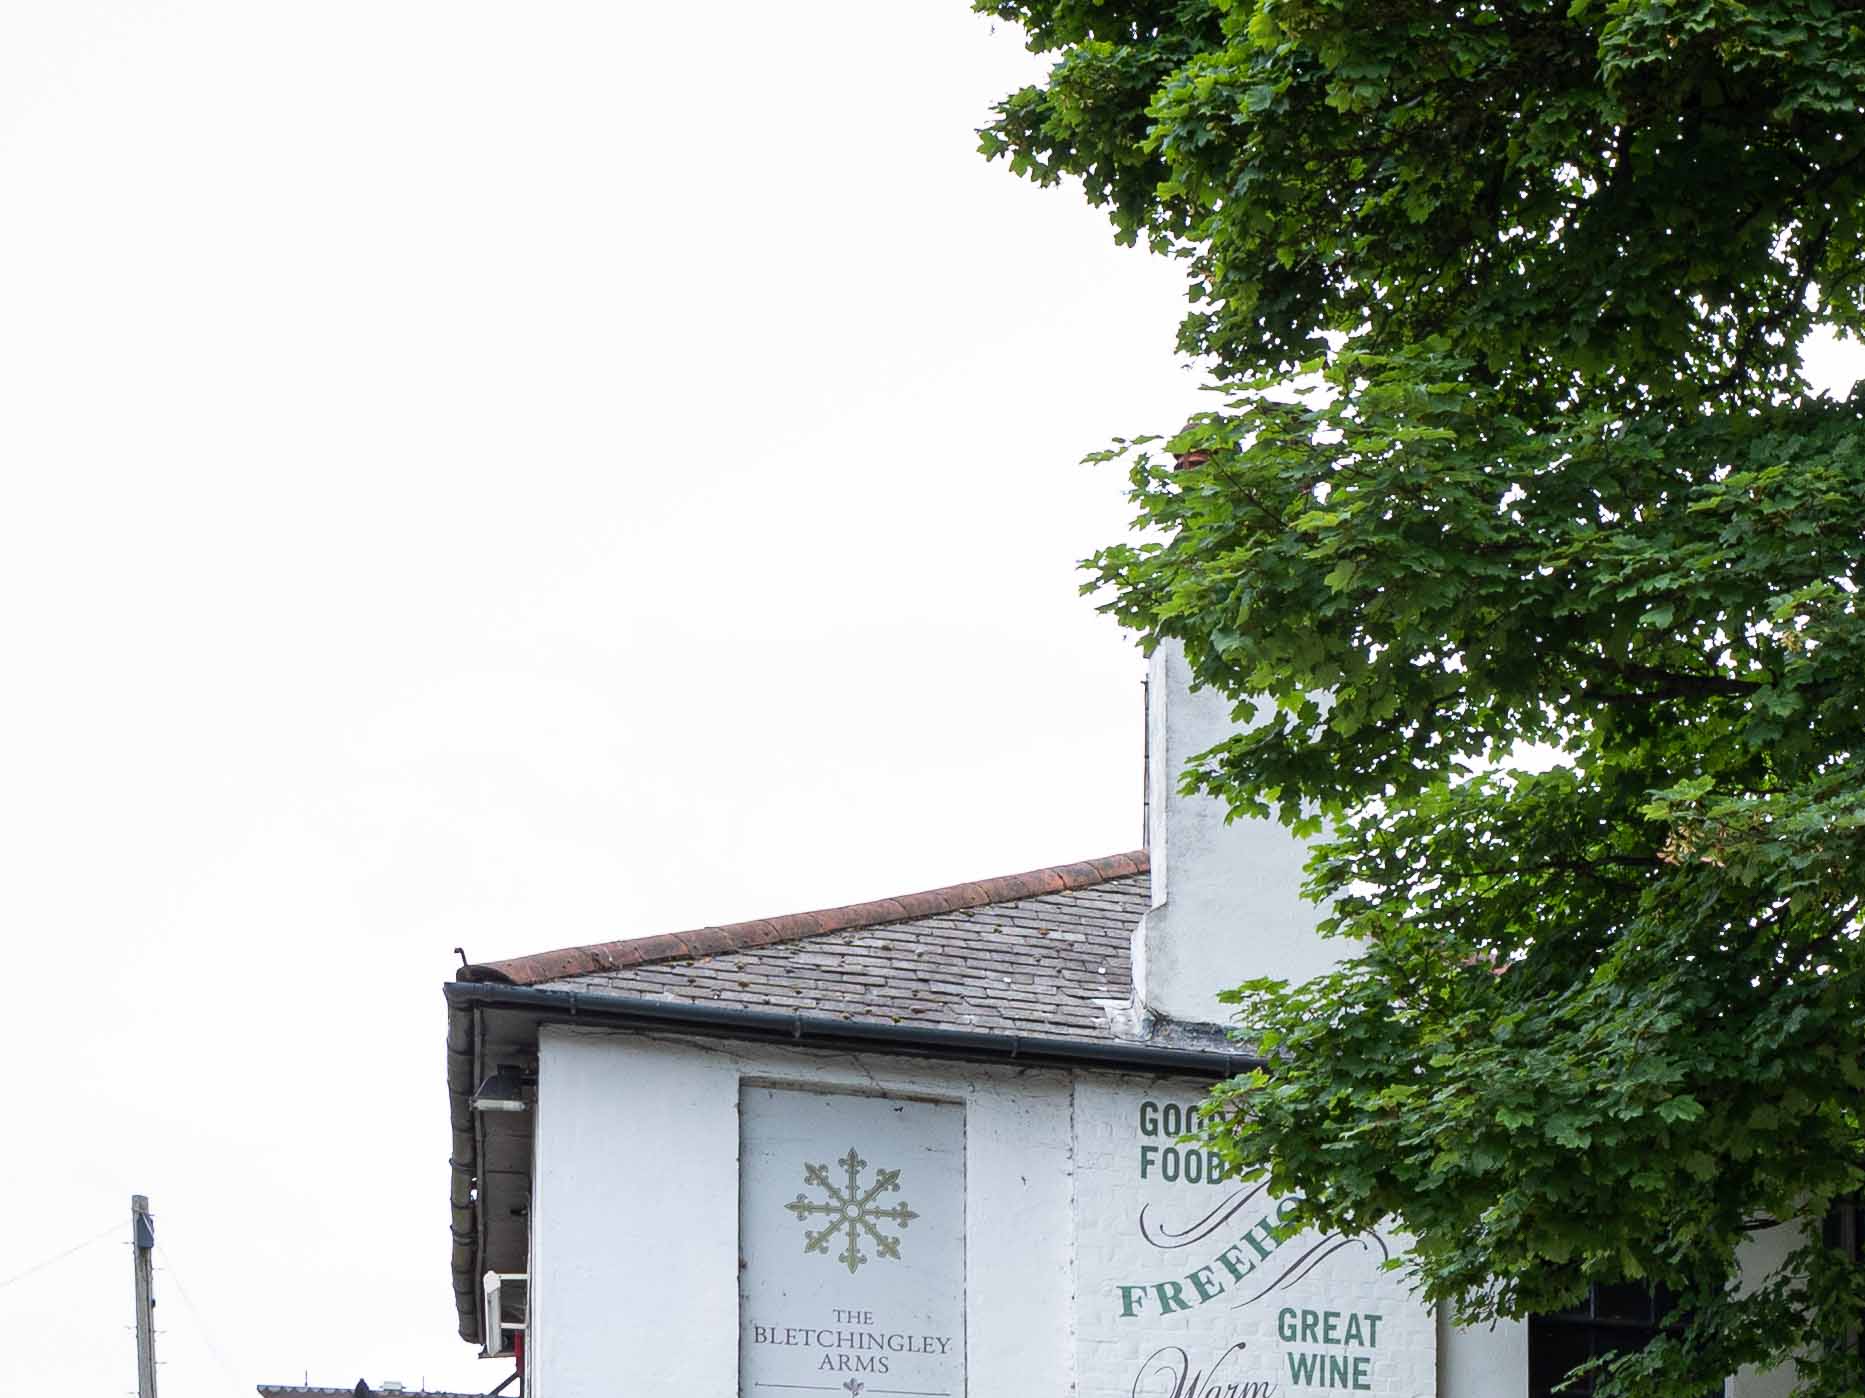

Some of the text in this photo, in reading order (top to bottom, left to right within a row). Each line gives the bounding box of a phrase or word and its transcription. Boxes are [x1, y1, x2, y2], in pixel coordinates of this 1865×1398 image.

[832, 1308, 875, 1327] THE
[1278, 1307, 1383, 1348] GREAT
[753, 1325, 952, 1356] BLETCHINGLEY
[818, 1353, 890, 1375] ARMS
[1286, 1351, 1372, 1391] WINE
